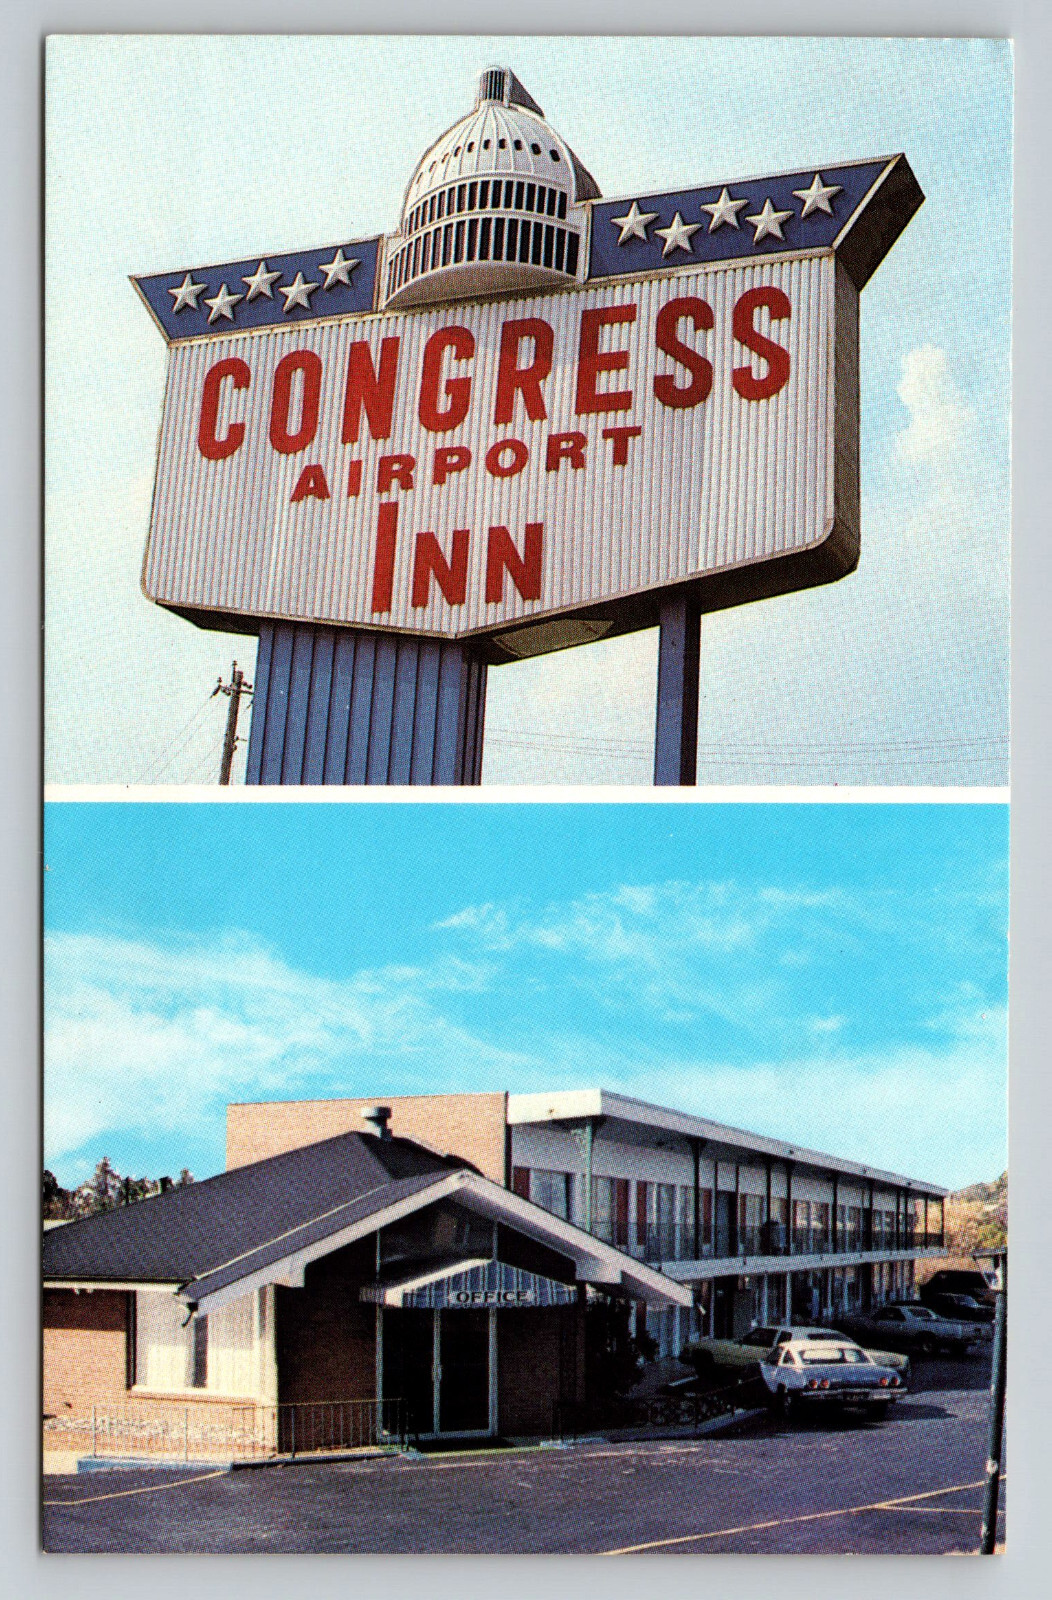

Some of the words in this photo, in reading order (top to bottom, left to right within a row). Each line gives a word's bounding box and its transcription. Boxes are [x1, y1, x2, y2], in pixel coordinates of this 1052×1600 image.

[197, 285, 792, 461] CONGRESS
[290, 425, 642, 503] AIRPORT
[371, 501, 544, 613] INN
[456, 1291, 528, 1303] OFFICE
